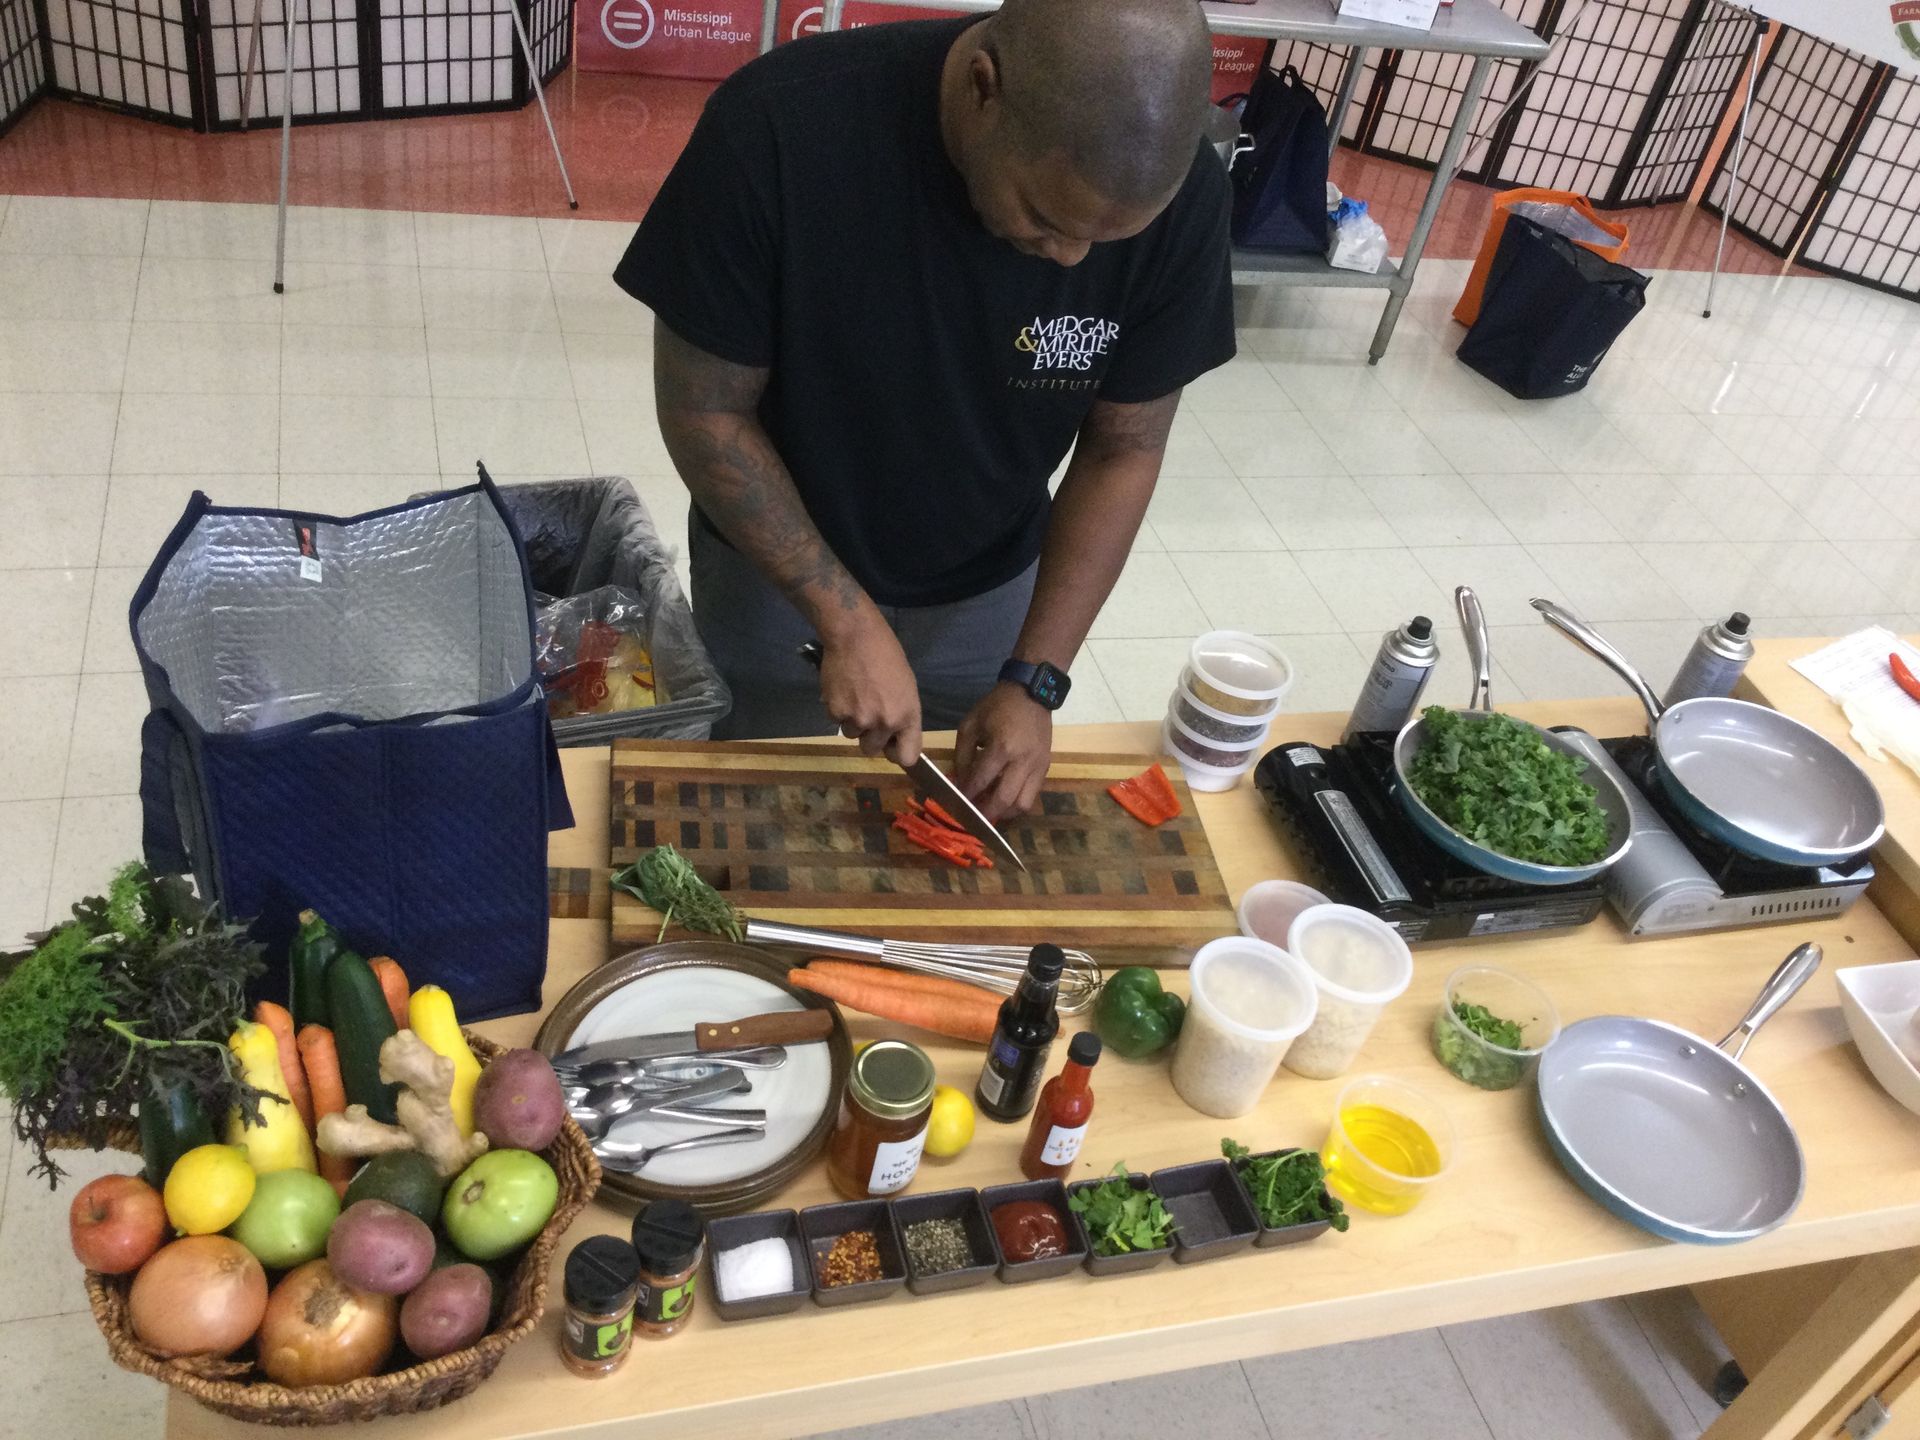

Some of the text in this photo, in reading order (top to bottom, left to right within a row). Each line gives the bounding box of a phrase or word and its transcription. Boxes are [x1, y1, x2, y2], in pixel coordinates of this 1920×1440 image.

[663, 8, 732, 27] Mississippi
[663, 24, 752, 44] Urban League
[1212, 46, 1245, 60] issippi
[1219, 60, 1255, 74] League
[1030, 315, 1120, 340] MEDGAR
[1014, 326, 1109, 355] & MYRLIE
[1032, 350, 1093, 371] EVERS
[1007, 377, 1102, 391] INSTITUTE
